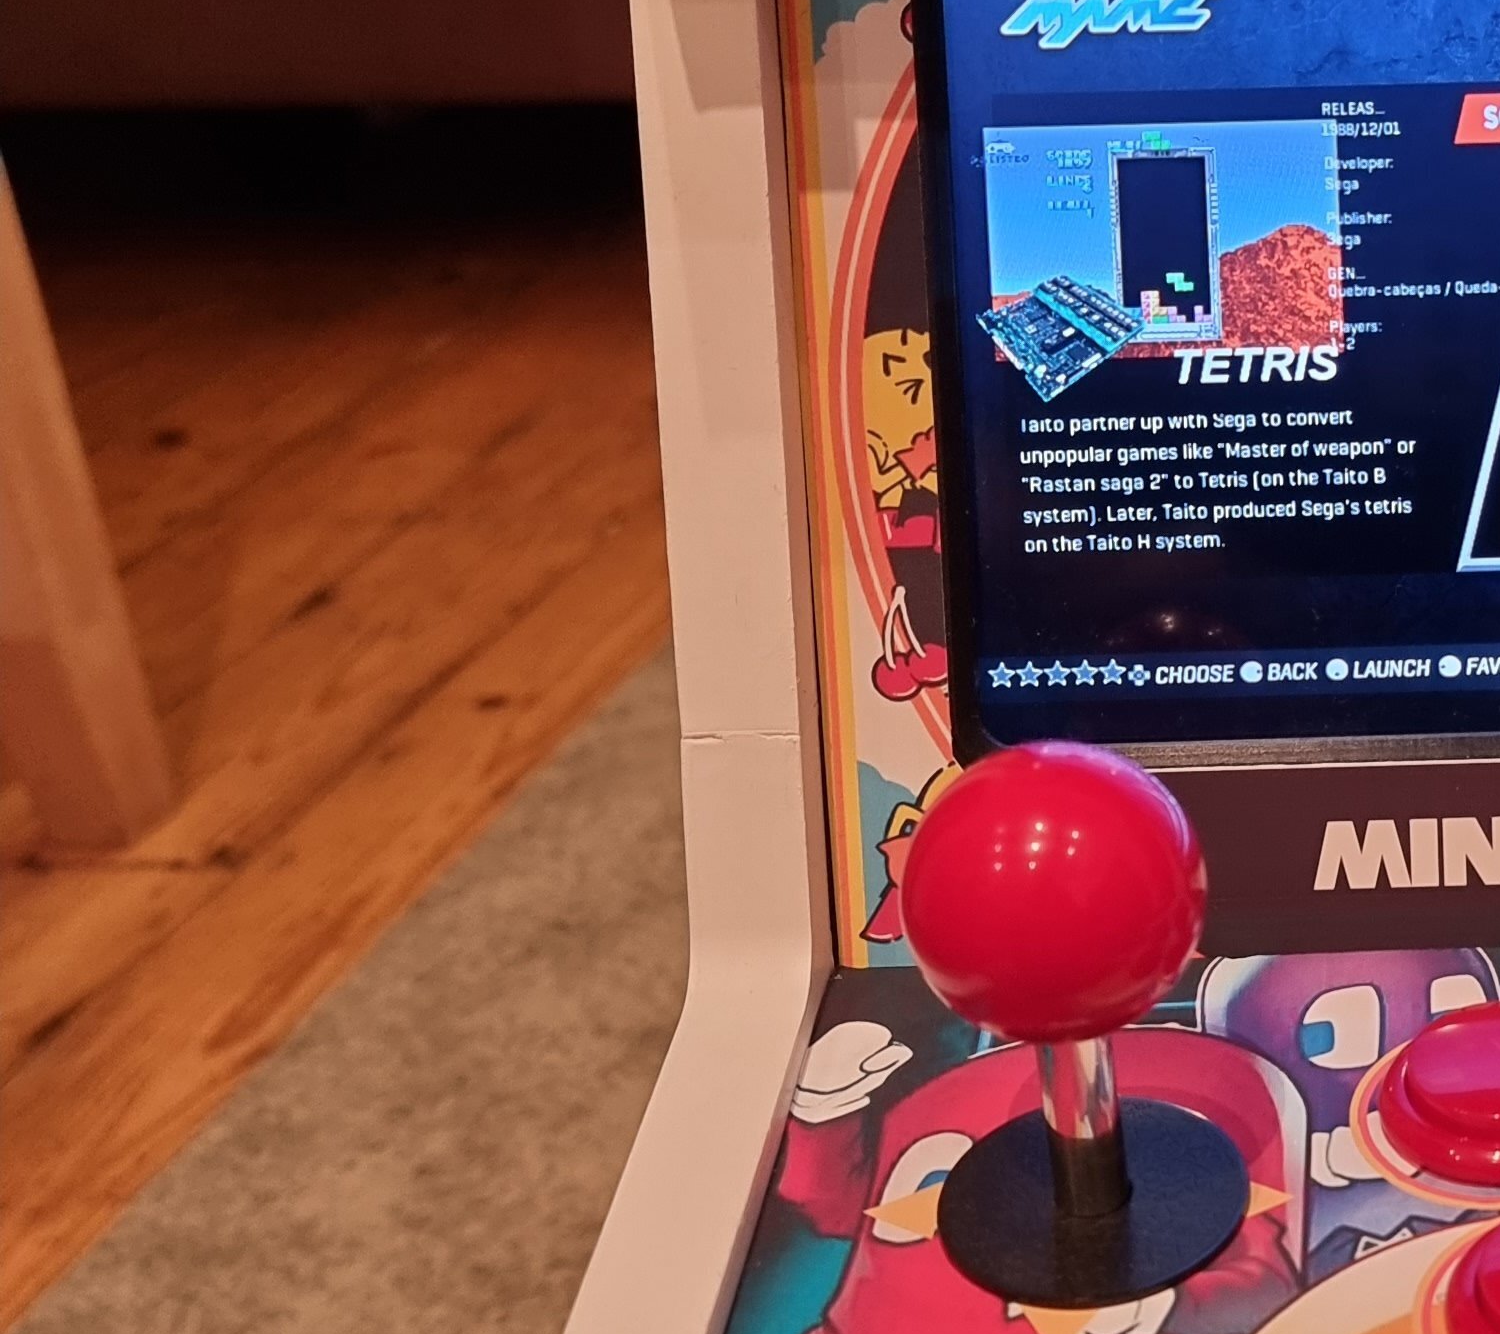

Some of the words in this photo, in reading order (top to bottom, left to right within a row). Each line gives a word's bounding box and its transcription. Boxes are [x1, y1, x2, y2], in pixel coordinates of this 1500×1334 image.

[1321, 121, 1401, 137] 1988/12/01
[1324, 156, 1394, 173] Developer:
[1324, 177, 1360, 195] Sega
[1326, 211, 1392, 225] Publisher:
[1329, 320, 1383, 336] Players:
[1173, 346, 1339, 385] TETRIS
[1021, 415, 1064, 433] Taito
[1070, 415, 1135, 436] partner
[1141, 418, 1163, 435] up
[1167, 413, 1207, 430] with
[1212, 413, 1256, 433] Sega
[1262, 412, 1281, 428] to
[1286, 409, 1353, 427] convert
[1020, 445, 1113, 468] unpopular
[1117, 446, 1178, 466] games
[1183, 442, 1213, 460] like
[1218, 441, 1286, 459] "Master
[1291, 440, 1310, 457] of
[1313, 438, 1392, 458] weapon"
[1397, 440, 1416, 454] or
[1022, 475, 1095, 493] "Rastan
[1100, 475, 1144, 495] saga
[1149, 473, 1169, 491] 2"
[1174, 474, 1193, 490] to
[1199, 470, 1248, 488] Tetris
[1253, 470, 1284, 491] (on
[1288, 469, 1319, 486] the
[1324, 468, 1369, 485] Taito
[1375, 467, 1387, 483] B
[1023, 505, 1101, 527] system).
[1107, 504, 1157, 524] Later,
[1163, 502, 1208, 521] Taito
[1213, 501, 1296, 524] produced
[1302, 499, 1360, 520] Sega's
[1365, 497, 1412, 515] tetris
[1025, 538, 1047, 554] on
[1052, 535, 1083, 552] the
[1086, 534, 1132, 551] Taito
[1138, 533, 1151, 549] H
[1156, 533, 1226, 553] system.
[1155, 664, 1234, 685] CHOOSE
[1267, 662, 1318, 682] BACK
[1353, 658, 1431, 679] LAUNCH
